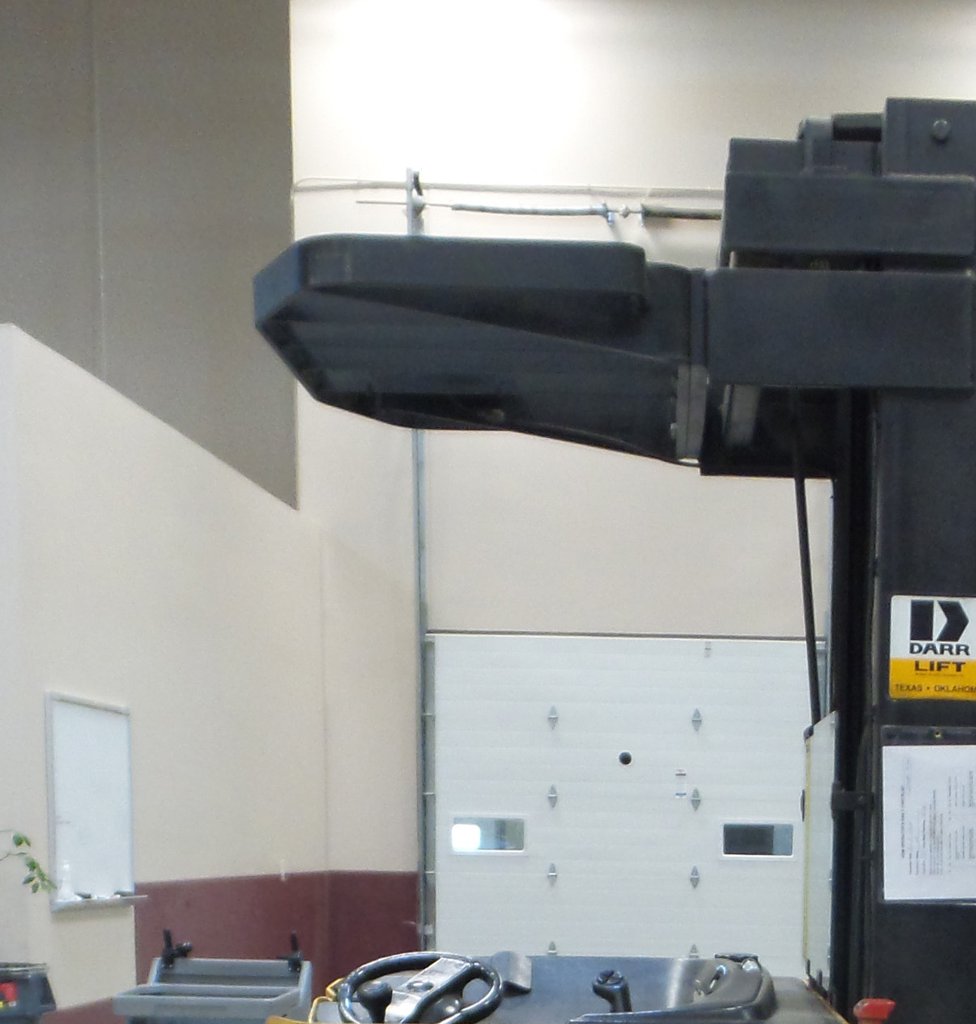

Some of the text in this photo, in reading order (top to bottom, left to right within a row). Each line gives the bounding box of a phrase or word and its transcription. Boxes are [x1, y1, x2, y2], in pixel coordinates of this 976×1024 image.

[909, 642, 970, 656] DARR
[914, 660, 966, 672] LIFT
[895, 683, 923, 692] TEXAS
